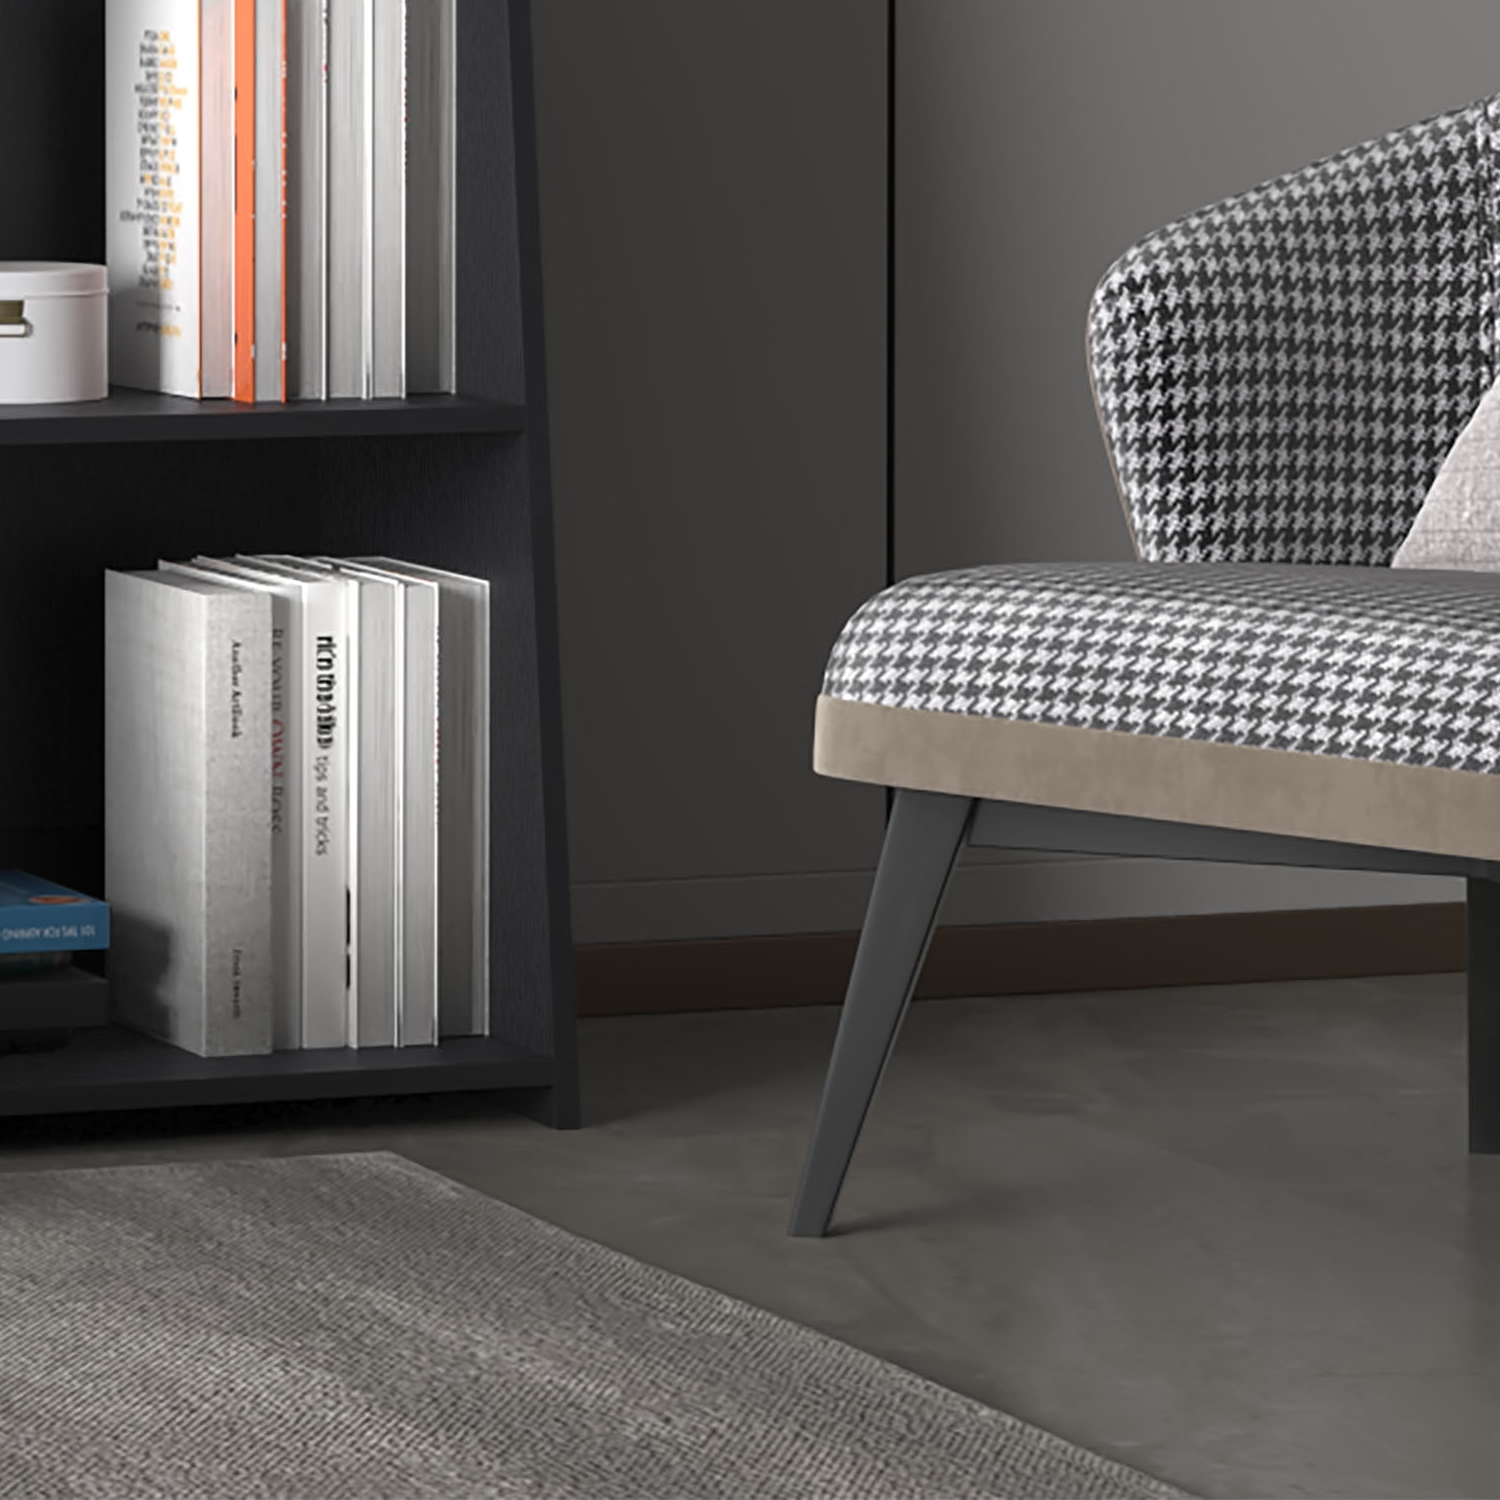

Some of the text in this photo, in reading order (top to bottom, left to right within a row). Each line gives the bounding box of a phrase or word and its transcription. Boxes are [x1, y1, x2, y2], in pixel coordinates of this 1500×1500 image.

[312, 755, 331, 781] tips
[315, 786, 330, 812] and
[315, 816, 331, 856] tricks
